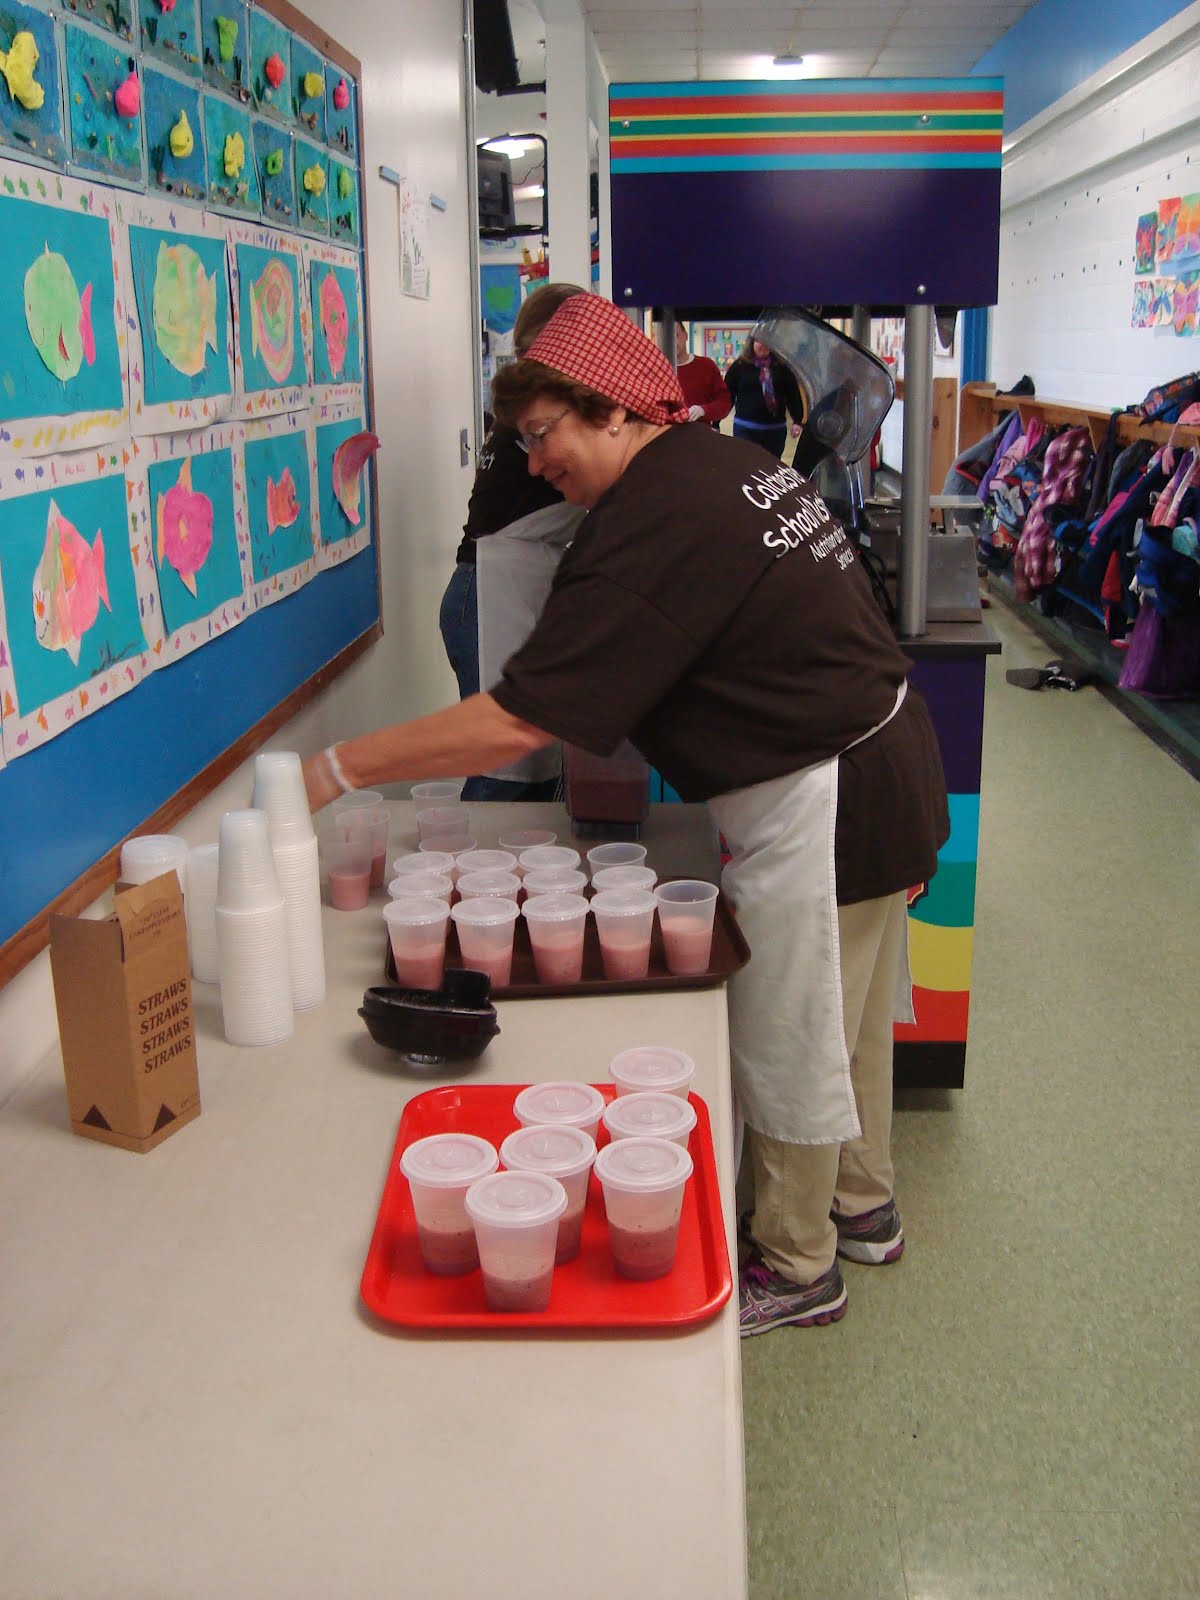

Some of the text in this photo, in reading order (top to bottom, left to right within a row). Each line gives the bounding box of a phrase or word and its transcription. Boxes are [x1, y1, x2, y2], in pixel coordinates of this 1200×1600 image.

[763, 497, 820, 558] School
[138, 978, 186, 1015] STRAWS
[141, 998, 188, 1035] STRAWS
[142, 1017, 189, 1054] STRAWS
[145, 1035, 191, 1073] STRAWS
